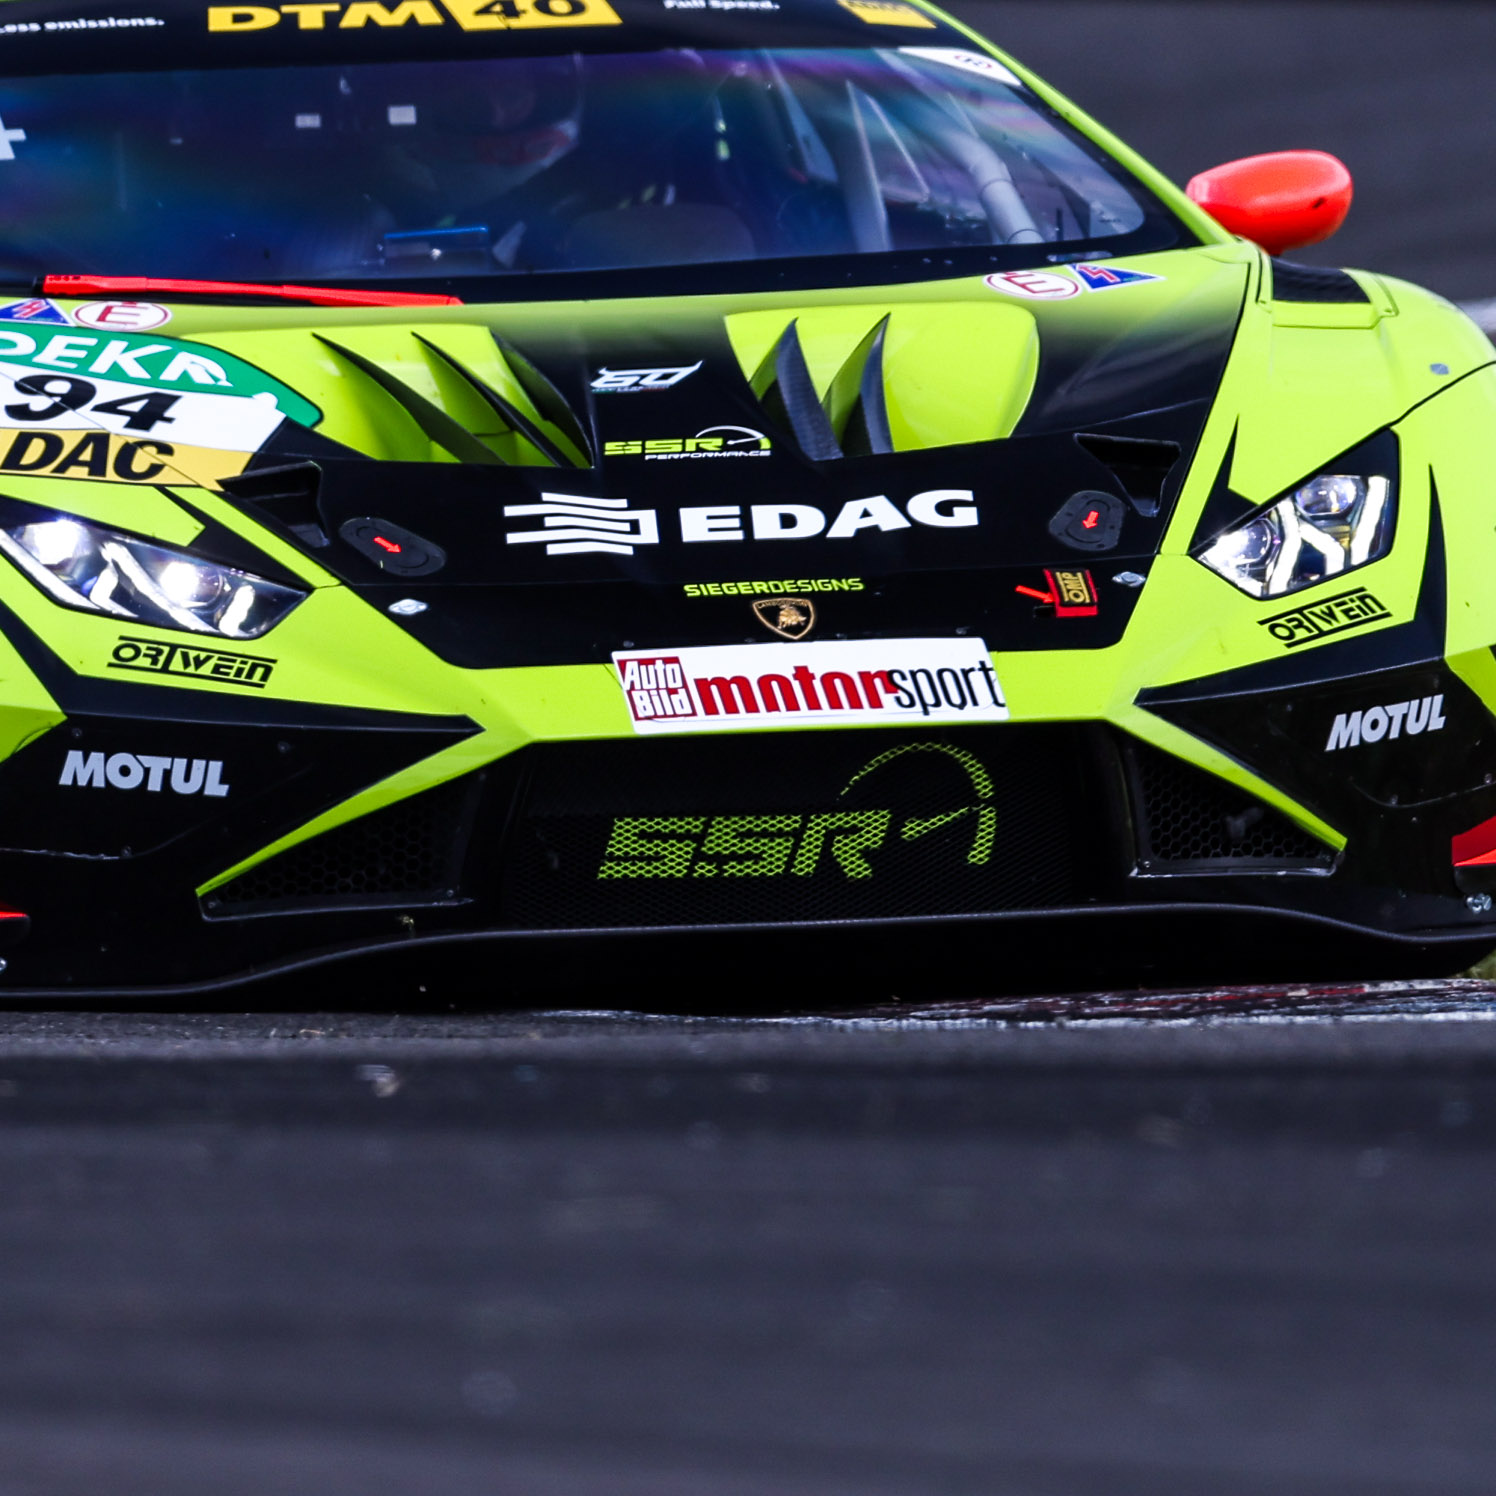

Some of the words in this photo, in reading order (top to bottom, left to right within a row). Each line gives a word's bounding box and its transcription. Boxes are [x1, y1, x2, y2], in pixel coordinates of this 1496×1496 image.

[45, 17, 165, 32] emissions.
[208, 0, 444, 32] DTM
[4, 374, 184, 432] 94
[604, 437, 724, 456] SSR
[644, 449, 772, 461] PERFORMANCE
[680, 489, 979, 542] EDAG
[683, 577, 865, 597] SIEGERDESIGNS
[623, 658, 683, 692] Auto
[630, 687, 693, 719] Bild
[1324, 694, 1447, 752] MOTUL
[58, 750, 230, 797] MOTUL
[596, 809, 892, 881] SSR
